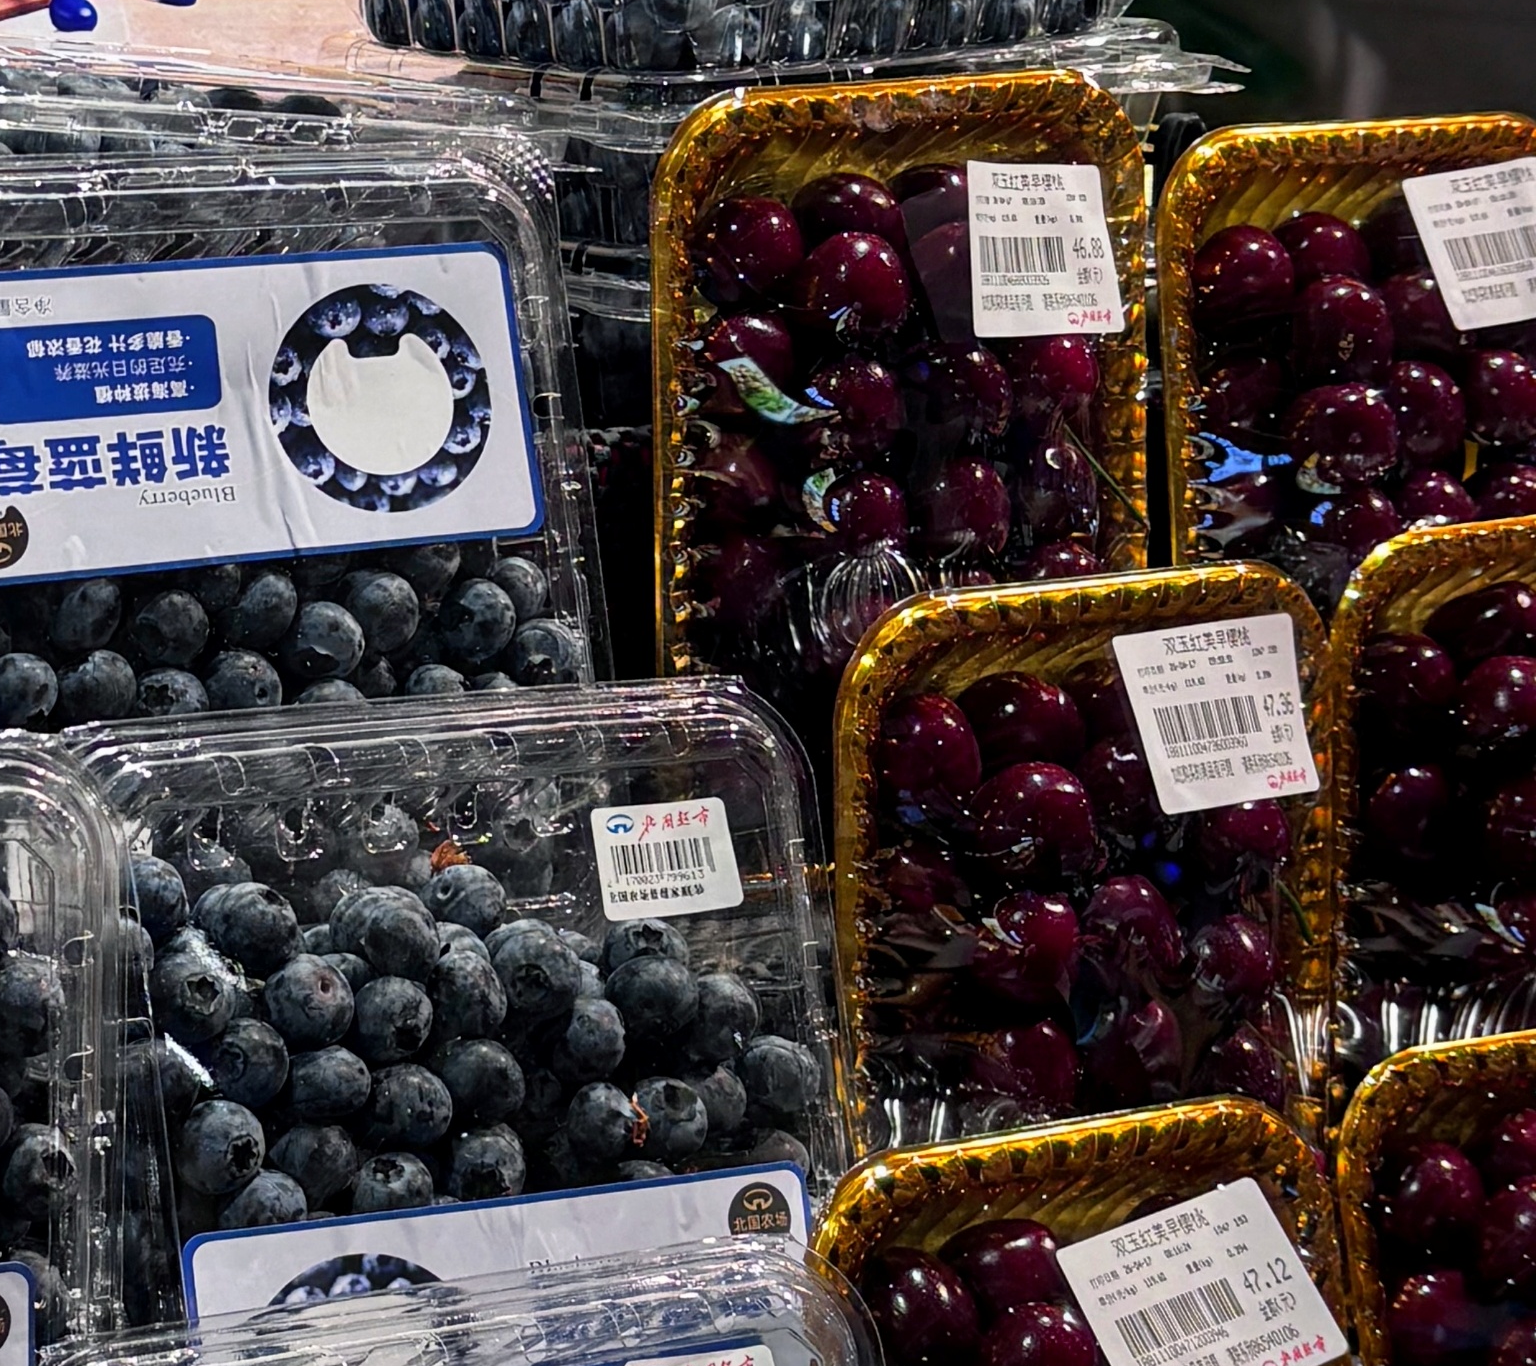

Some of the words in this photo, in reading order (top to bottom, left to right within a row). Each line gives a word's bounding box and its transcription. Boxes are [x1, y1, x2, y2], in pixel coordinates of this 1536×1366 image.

[54, 355, 186, 382] 充足的日光滋养
[95, 382, 188, 404] 高海拔种植
[138, 485, 236, 508] Blueberry
[1111, 1208, 1210, 1257] 双玉红美早樱桃
[1243, 1257, 1292, 1296] 47.12
